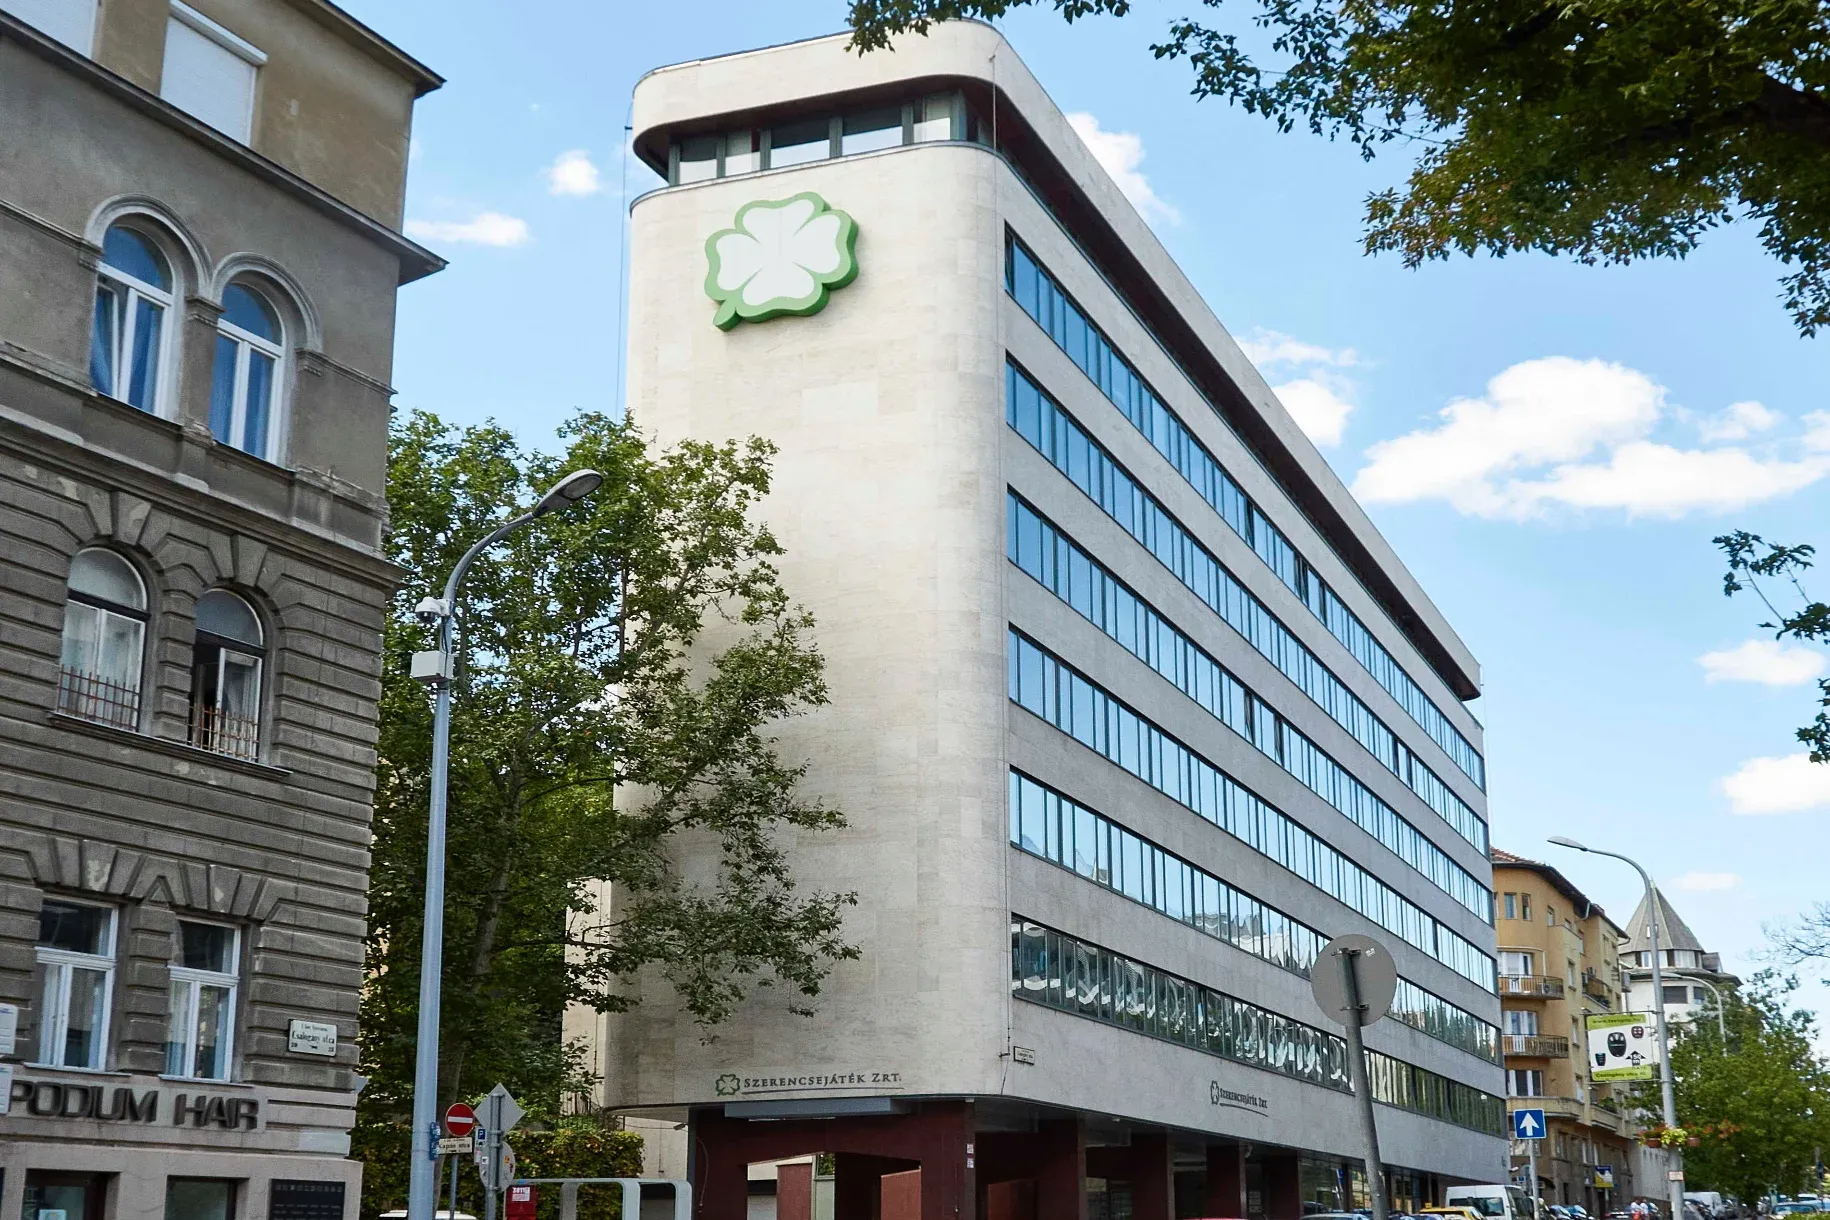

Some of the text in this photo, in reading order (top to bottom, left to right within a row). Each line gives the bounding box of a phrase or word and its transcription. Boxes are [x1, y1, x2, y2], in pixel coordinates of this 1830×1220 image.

[744, 1073, 866, 1088] SZERENCSEJÁTÉK
[8, 1079, 259, 1129] PODIUM HAIR
